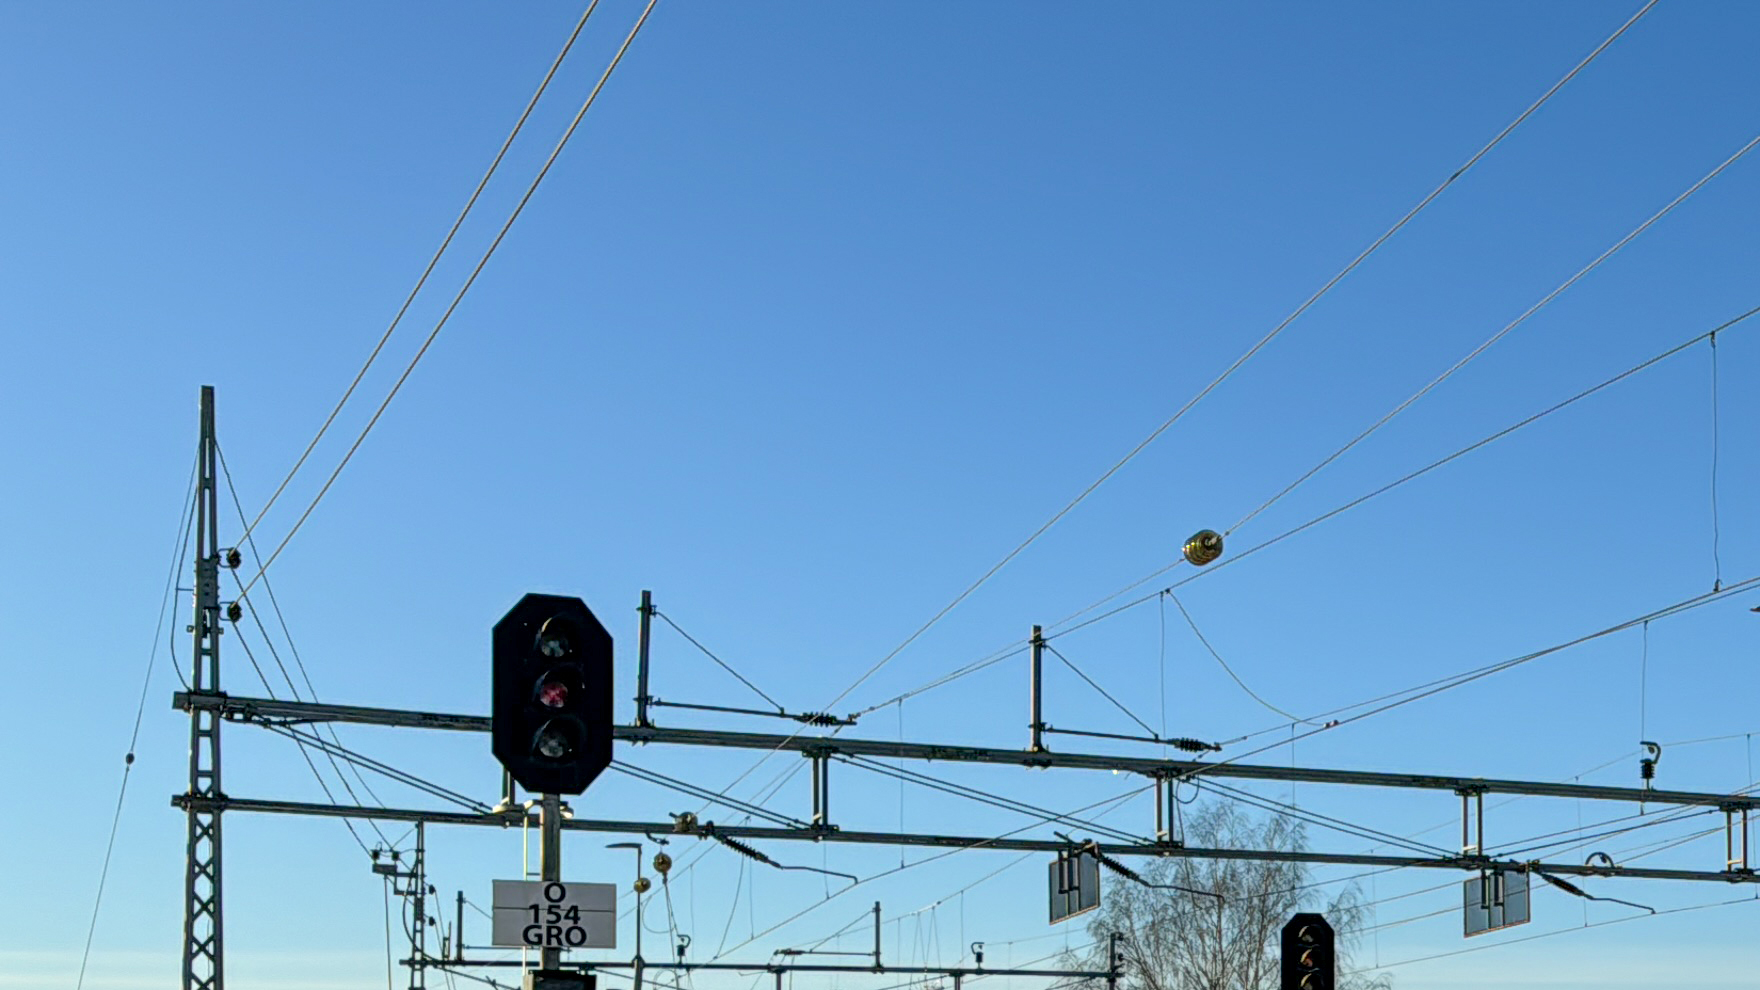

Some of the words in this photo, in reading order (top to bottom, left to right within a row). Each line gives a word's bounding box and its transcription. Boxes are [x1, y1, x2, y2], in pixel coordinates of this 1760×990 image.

[544, 882, 566, 903] O
[529, 904, 581, 925] 154
[522, 924, 587, 947] GRO
